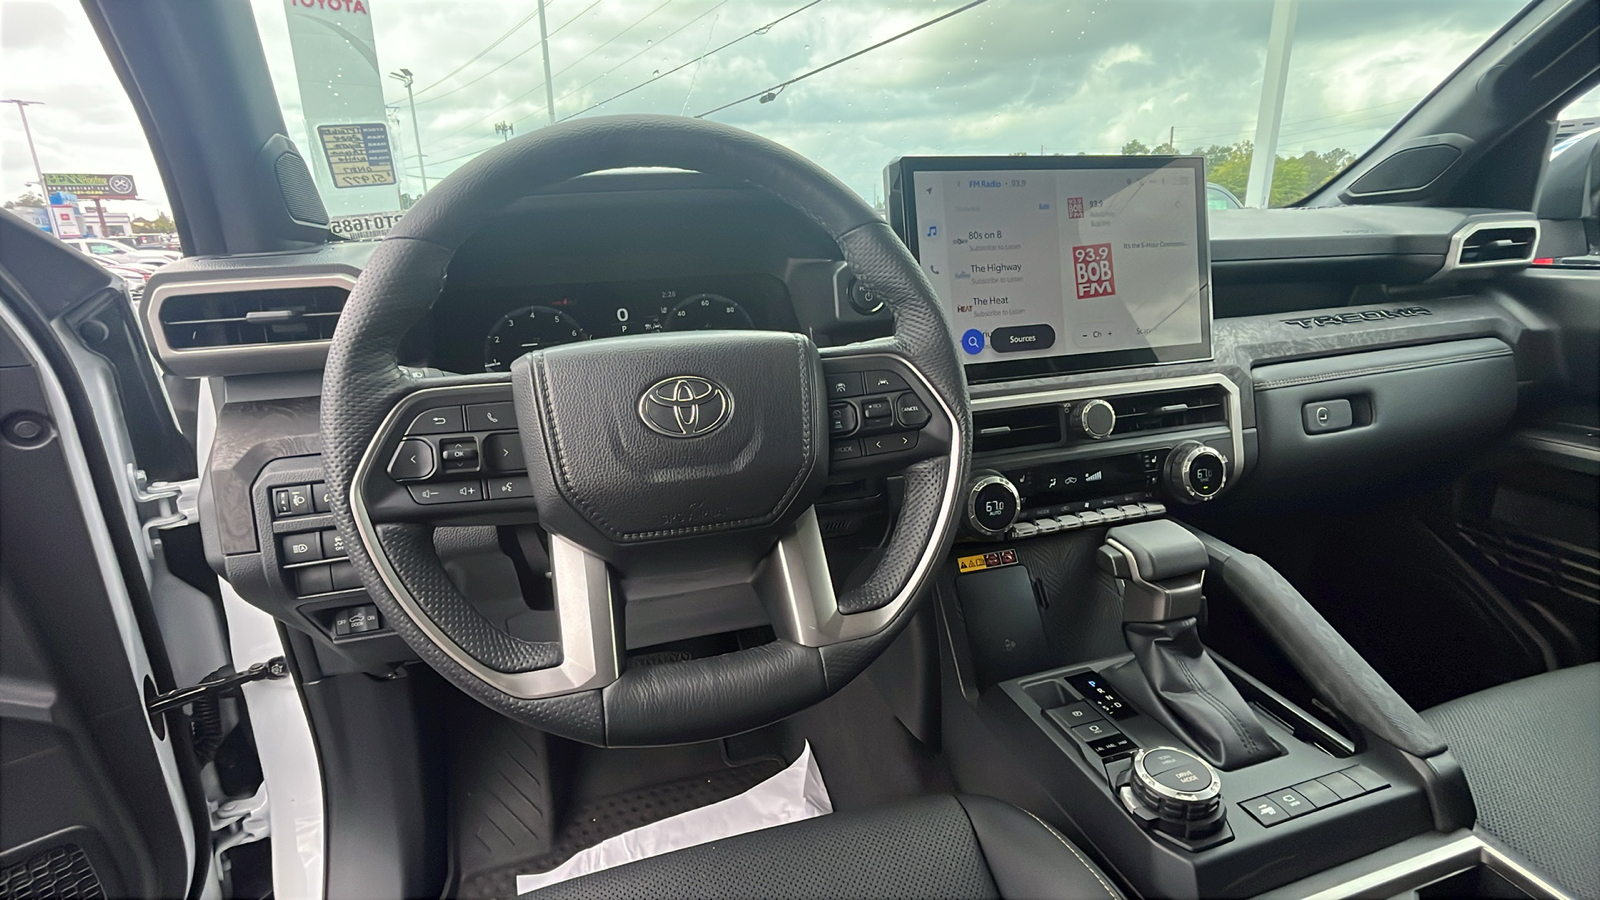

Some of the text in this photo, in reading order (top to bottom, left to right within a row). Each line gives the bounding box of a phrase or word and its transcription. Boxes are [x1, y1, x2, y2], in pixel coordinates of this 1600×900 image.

[969, 180, 980, 188] FM
[981, 180, 1002, 188] Radio
[968, 230, 1003, 240] 80s on 8
[1075, 246, 1109, 262] 93.9
[971, 262, 1022, 274] The Highway
[1076, 260, 1112, 284] BOB
[971, 277, 1000, 285] Subscribe
[1078, 281, 1113, 297] FM
[973, 296, 1009, 306] The Heat
[957, 305, 973, 313] HEAT
[616, 307, 629, 322] 0
[973, 310, 1001, 318] Subscribe
[571, 329, 577, 337] 6
[621, 325, 628, 333] P
[1092, 330, 1102, 338] Ch
[1009, 335, 1036, 344] Sources
[1180, 774, 1199, 783] MODE
